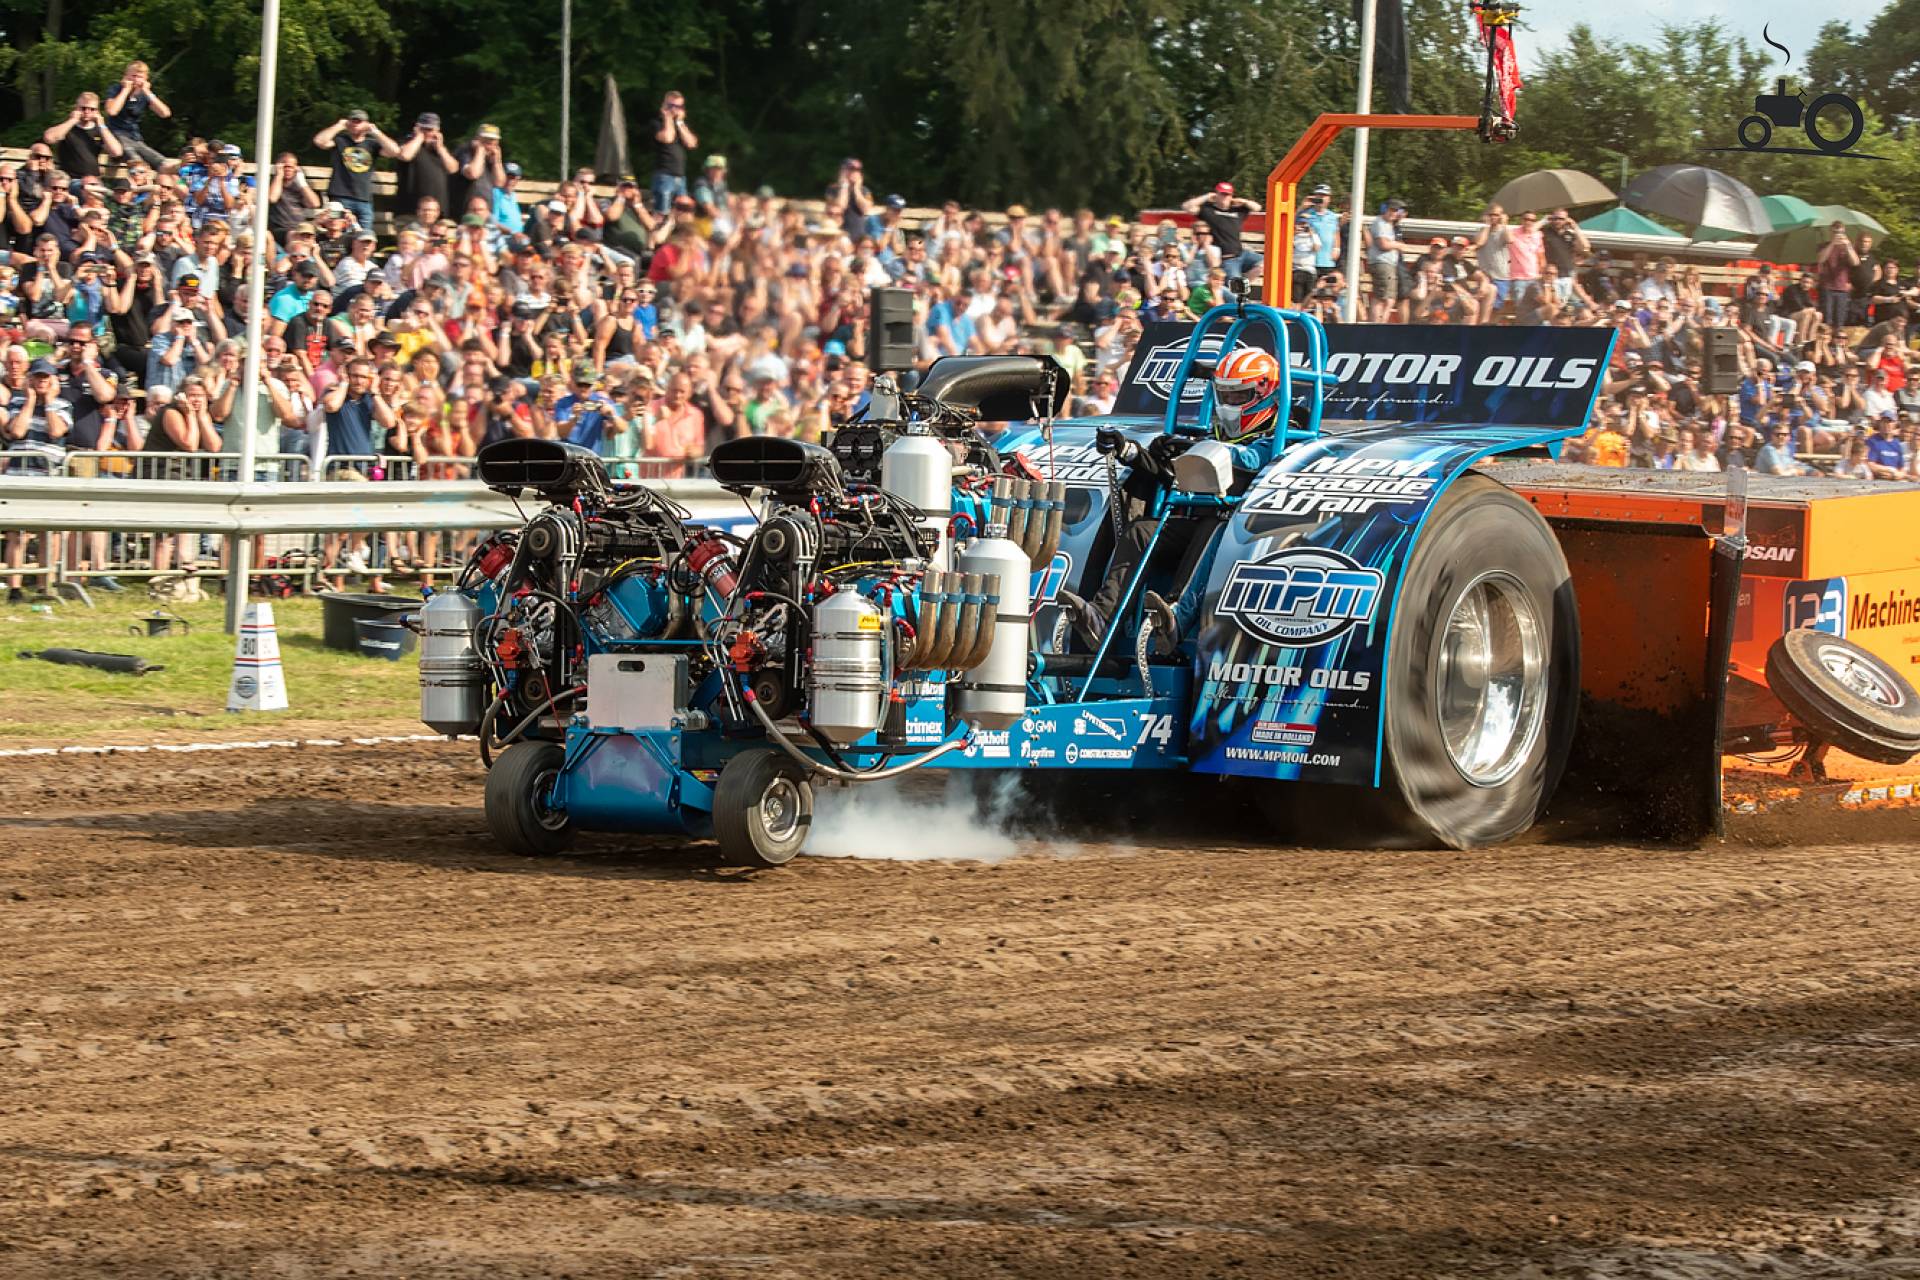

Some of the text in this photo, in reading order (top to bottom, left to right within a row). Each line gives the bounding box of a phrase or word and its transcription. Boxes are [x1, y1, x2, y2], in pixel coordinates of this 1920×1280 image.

[1473, 355, 1597, 389] OILS
[1301, 457, 1438, 477] MPM
[1259, 472, 1438, 495] Seaside
[1241, 489, 1422, 515] Affair
[1850, 588, 1920, 631] Machine
[1255, 616, 1329, 637] OIL COMPANY
[1208, 663, 1371, 692] MOTOR OILS
[906, 717, 942, 734] trimex
[1136, 714, 1173, 746] 74
[1255, 730, 1274, 740] MADE
[1282, 733, 1312, 743] HOLLAND
[1225, 746, 1341, 767] WWW.MPMOIL.COM
